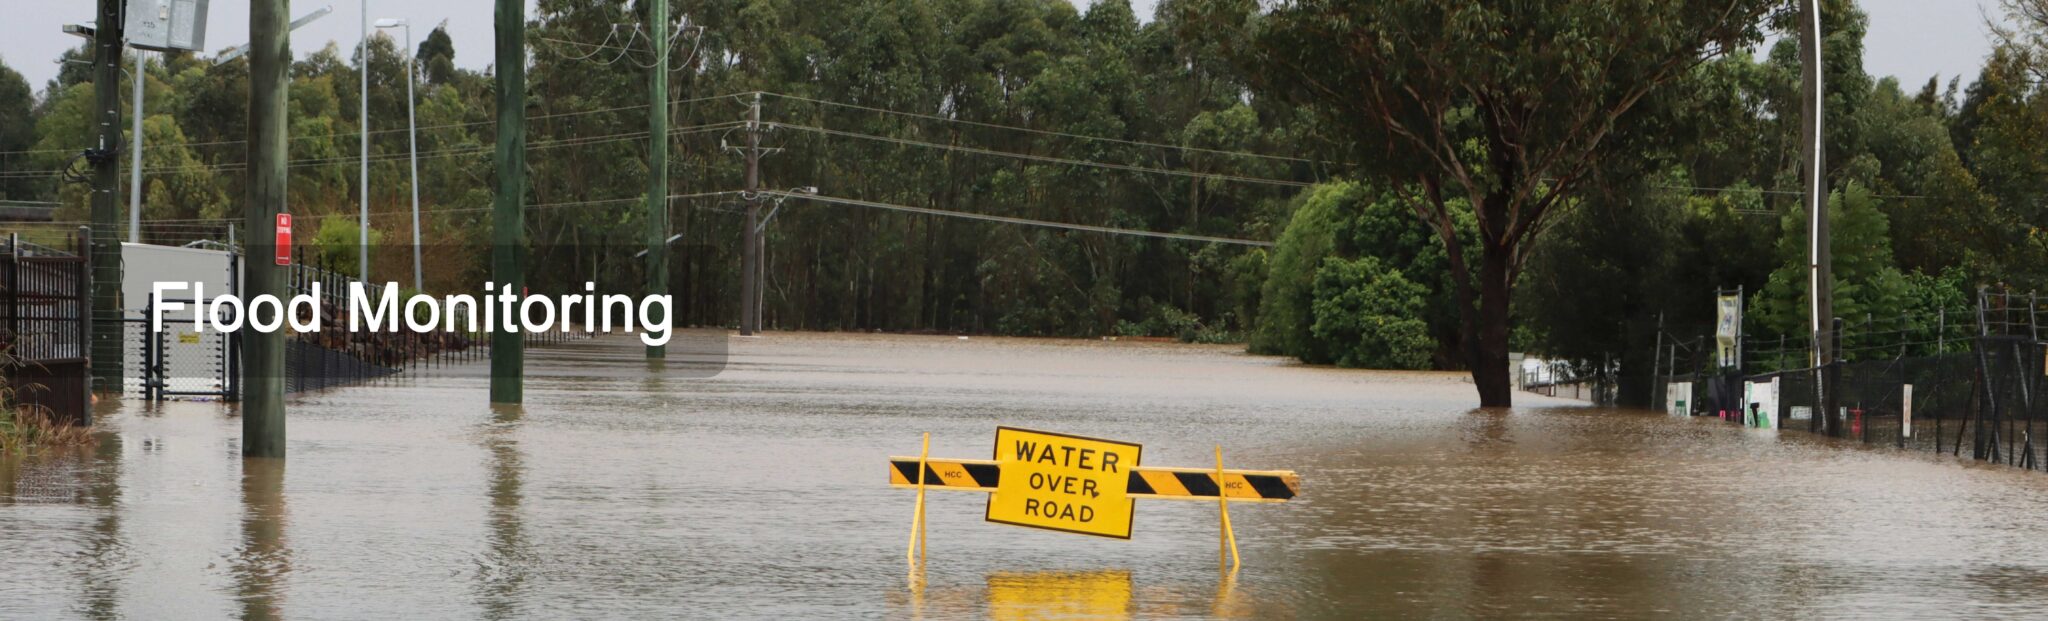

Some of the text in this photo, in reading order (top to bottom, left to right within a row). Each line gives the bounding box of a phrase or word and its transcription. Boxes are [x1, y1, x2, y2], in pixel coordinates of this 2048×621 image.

[1016, 440, 1119, 473] WATER
[1029, 472, 1099, 498] OVER
[1025, 498, 1094, 523] ROAD
